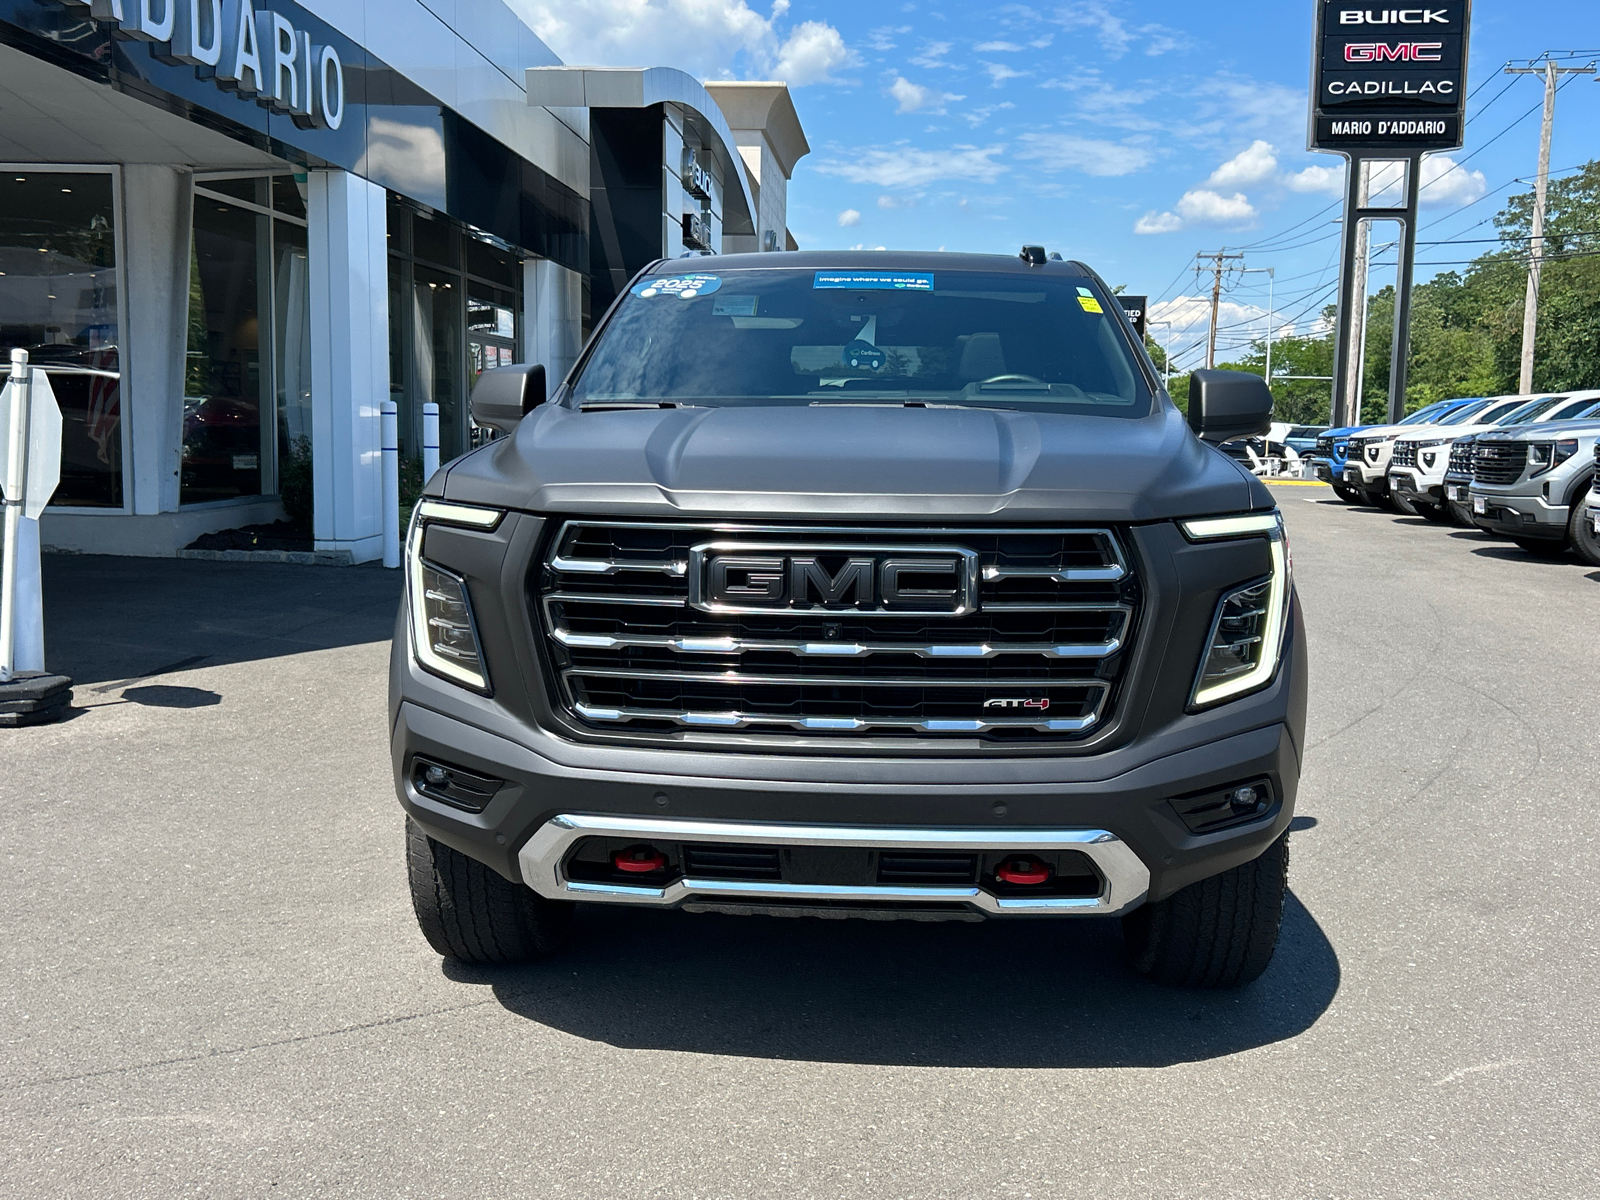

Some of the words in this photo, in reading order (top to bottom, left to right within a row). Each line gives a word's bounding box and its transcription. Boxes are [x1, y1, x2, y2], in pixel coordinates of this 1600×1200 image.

[1339, 9, 1450, 25] BUICK
[1344, 42, 1443, 62] GMC
[1328, 81, 1454, 95] CADILLAC
[1331, 121, 1372, 135] MARIO
[1378, 121, 1446, 135] D'ADDARIO
[651, 279, 706, 289] 2025
[708, 556, 958, 602] GMC
[983, 698, 1050, 711] AT4
